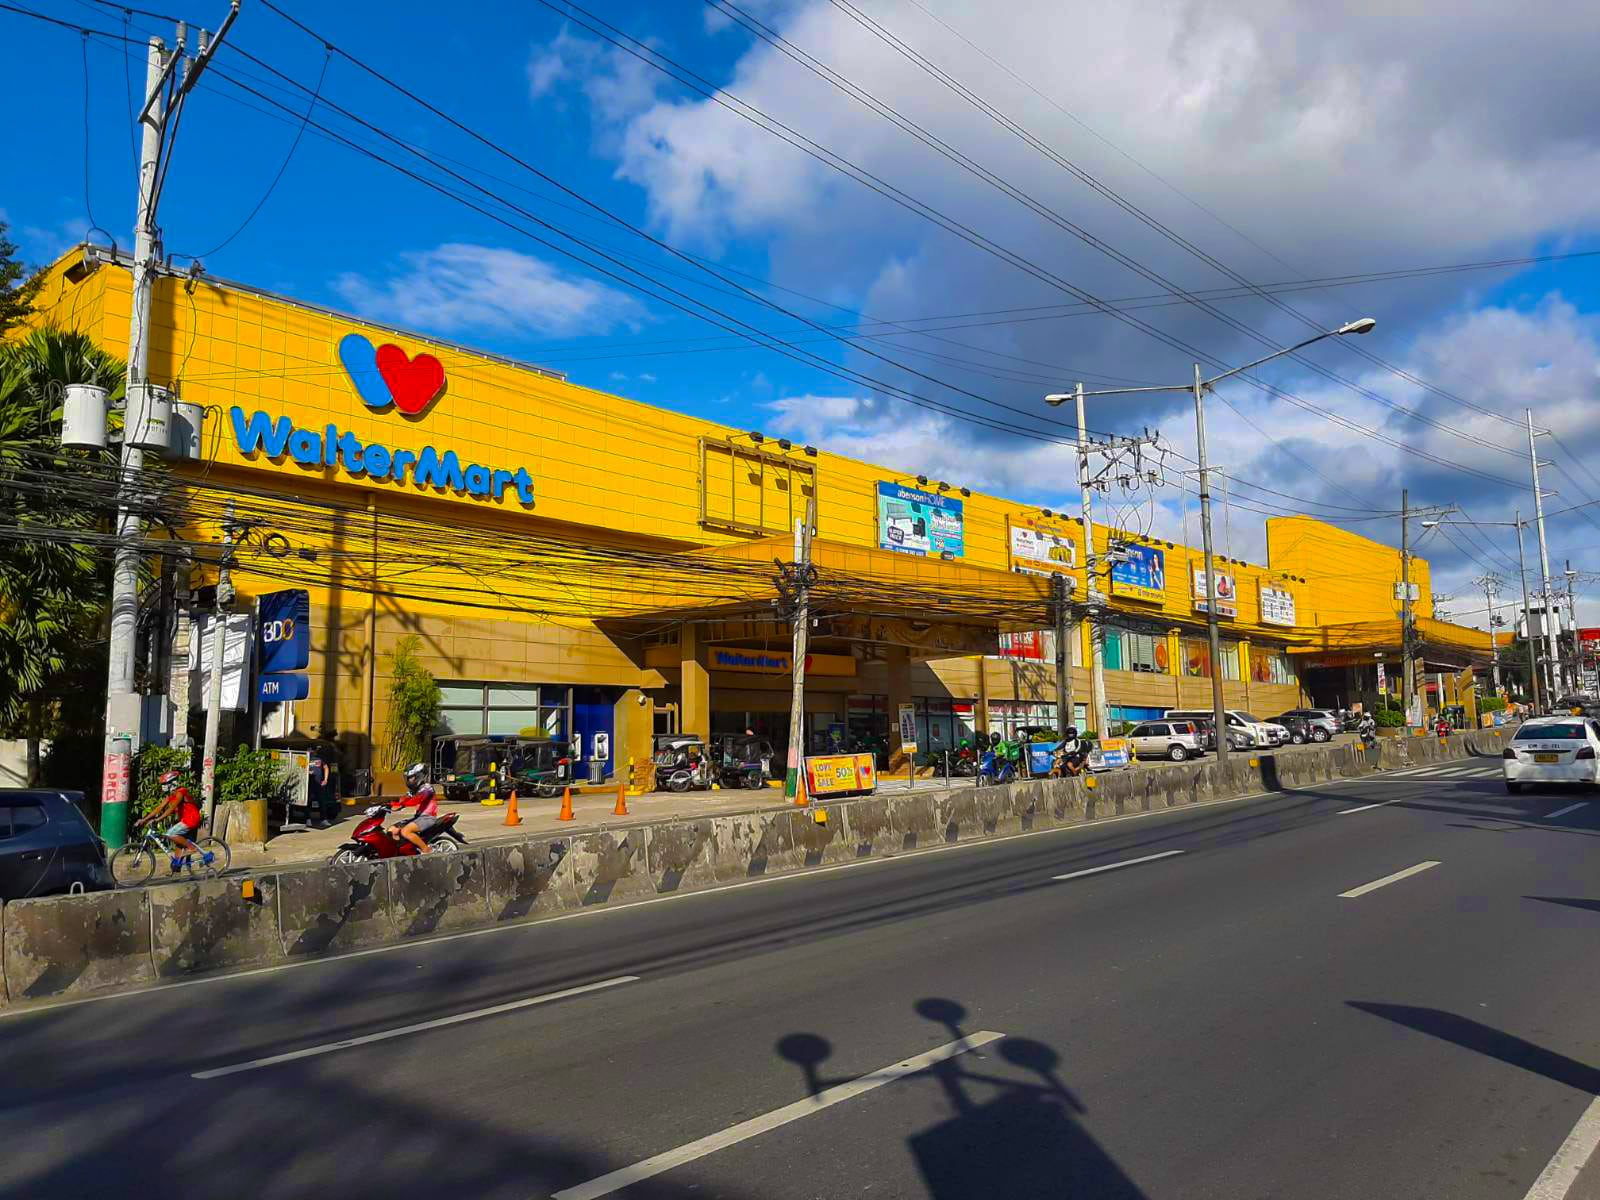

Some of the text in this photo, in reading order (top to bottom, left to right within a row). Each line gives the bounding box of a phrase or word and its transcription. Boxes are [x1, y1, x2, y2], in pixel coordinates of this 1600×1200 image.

[230, 406, 535, 504] WalterMart
[263, 618, 296, 643] BDO
[262, 681, 280, 694] ATM
